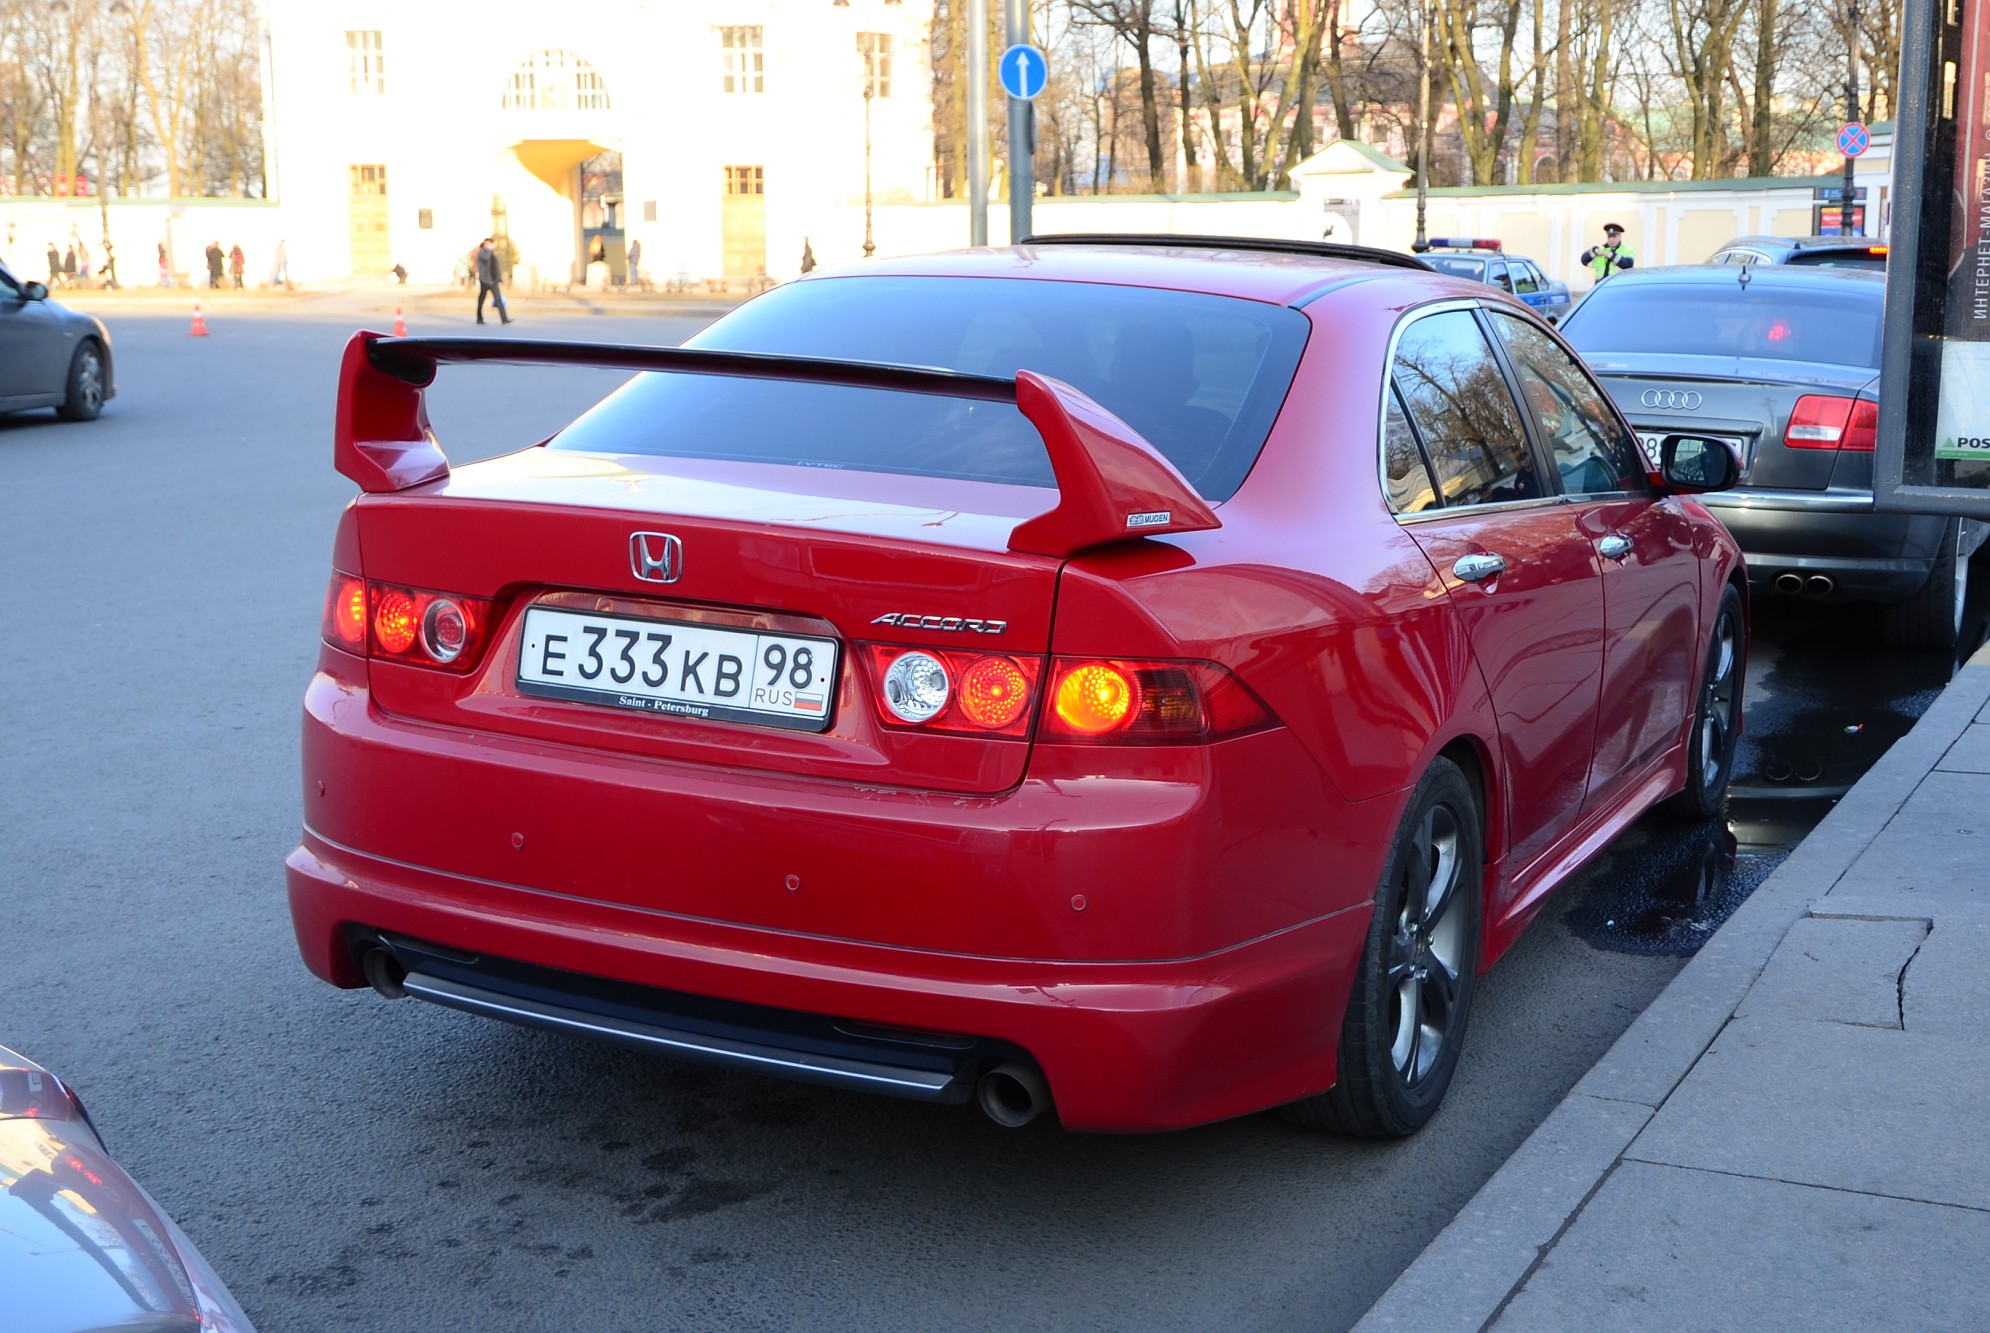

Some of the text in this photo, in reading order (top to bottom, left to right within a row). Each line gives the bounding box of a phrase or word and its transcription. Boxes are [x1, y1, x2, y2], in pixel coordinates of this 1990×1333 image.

[1957, 437, 1990, 449] POS
[1144, 514, 1168, 523] MUGEN
[870, 612, 1007, 634] ACCORD
[763, 643, 813, 690] 98
[619, 696, 645, 708] Saint
[653, 700, 709, 717] Petersburg
[754, 687, 793, 706] RUS
